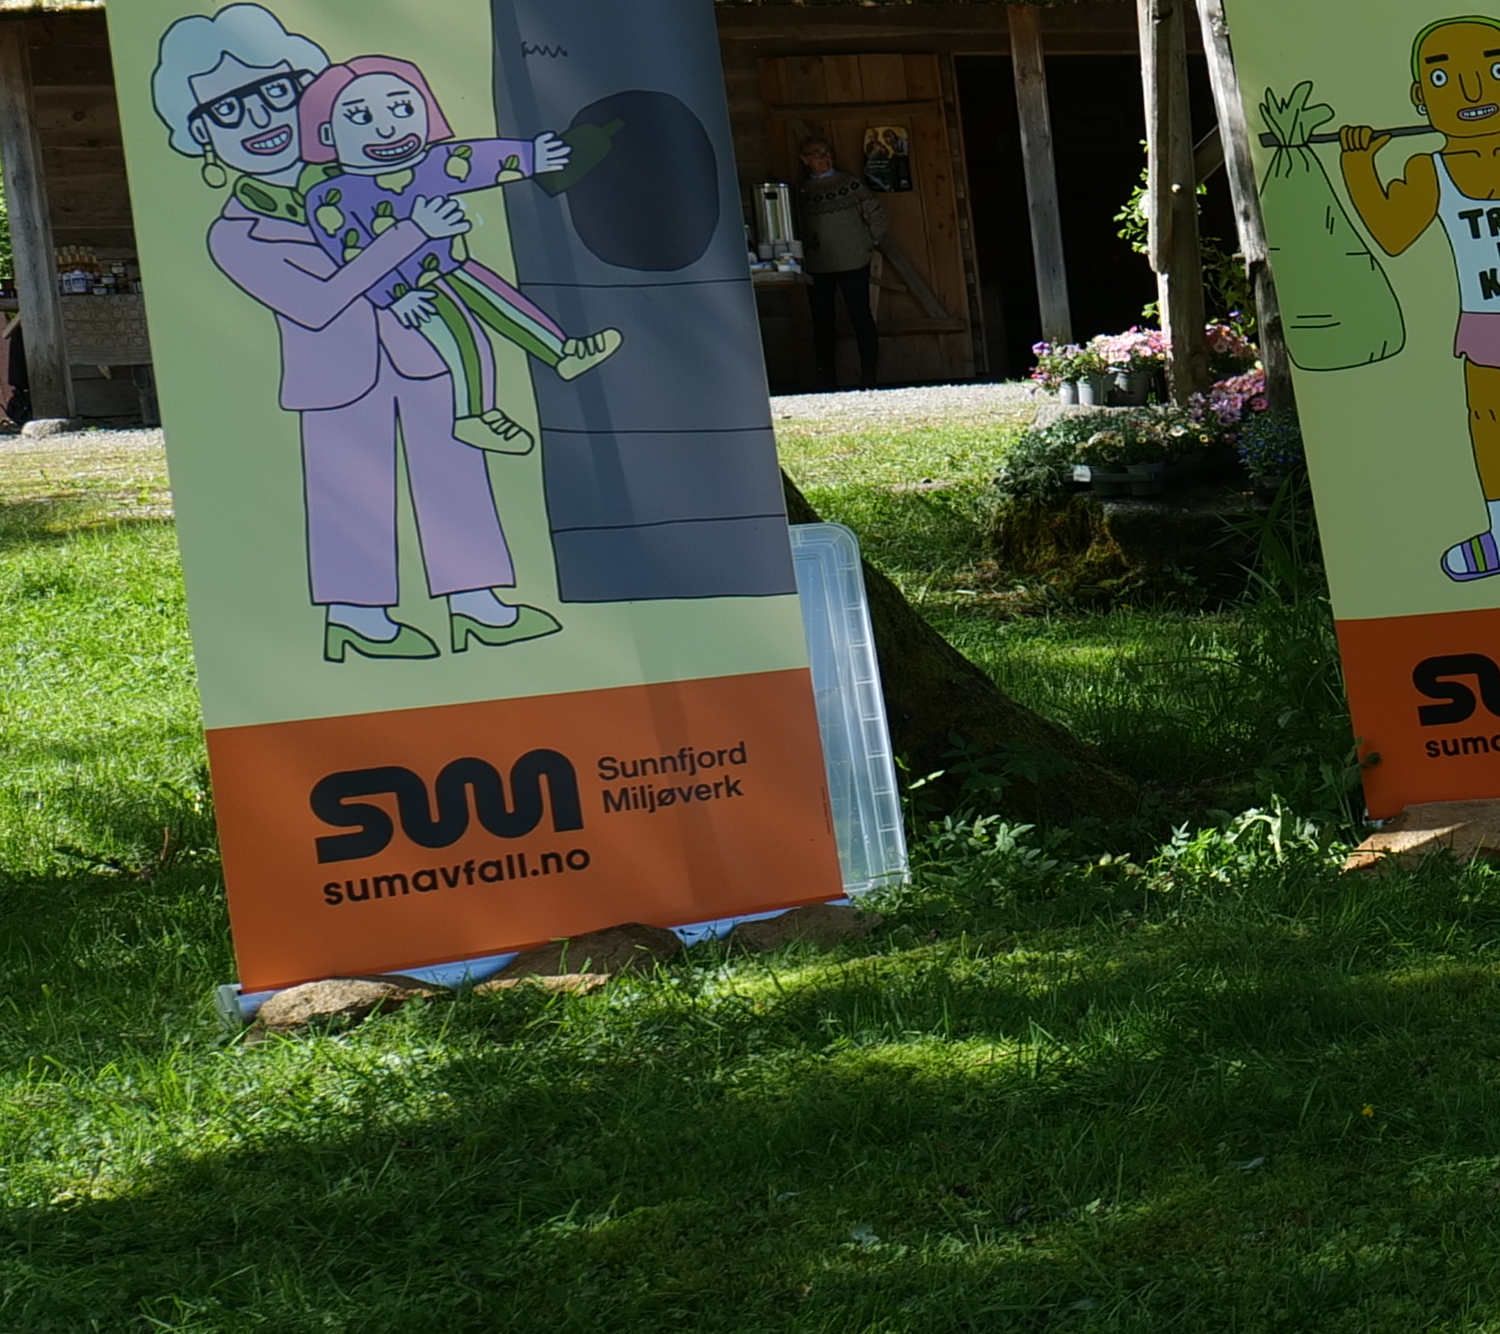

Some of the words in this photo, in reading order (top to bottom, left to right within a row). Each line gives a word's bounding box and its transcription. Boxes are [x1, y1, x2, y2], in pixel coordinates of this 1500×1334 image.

[597, 741, 748, 783] Sunnfjord
[602, 773, 745, 814] Miljøverk
[322, 845, 592, 907] sumavfall.no
